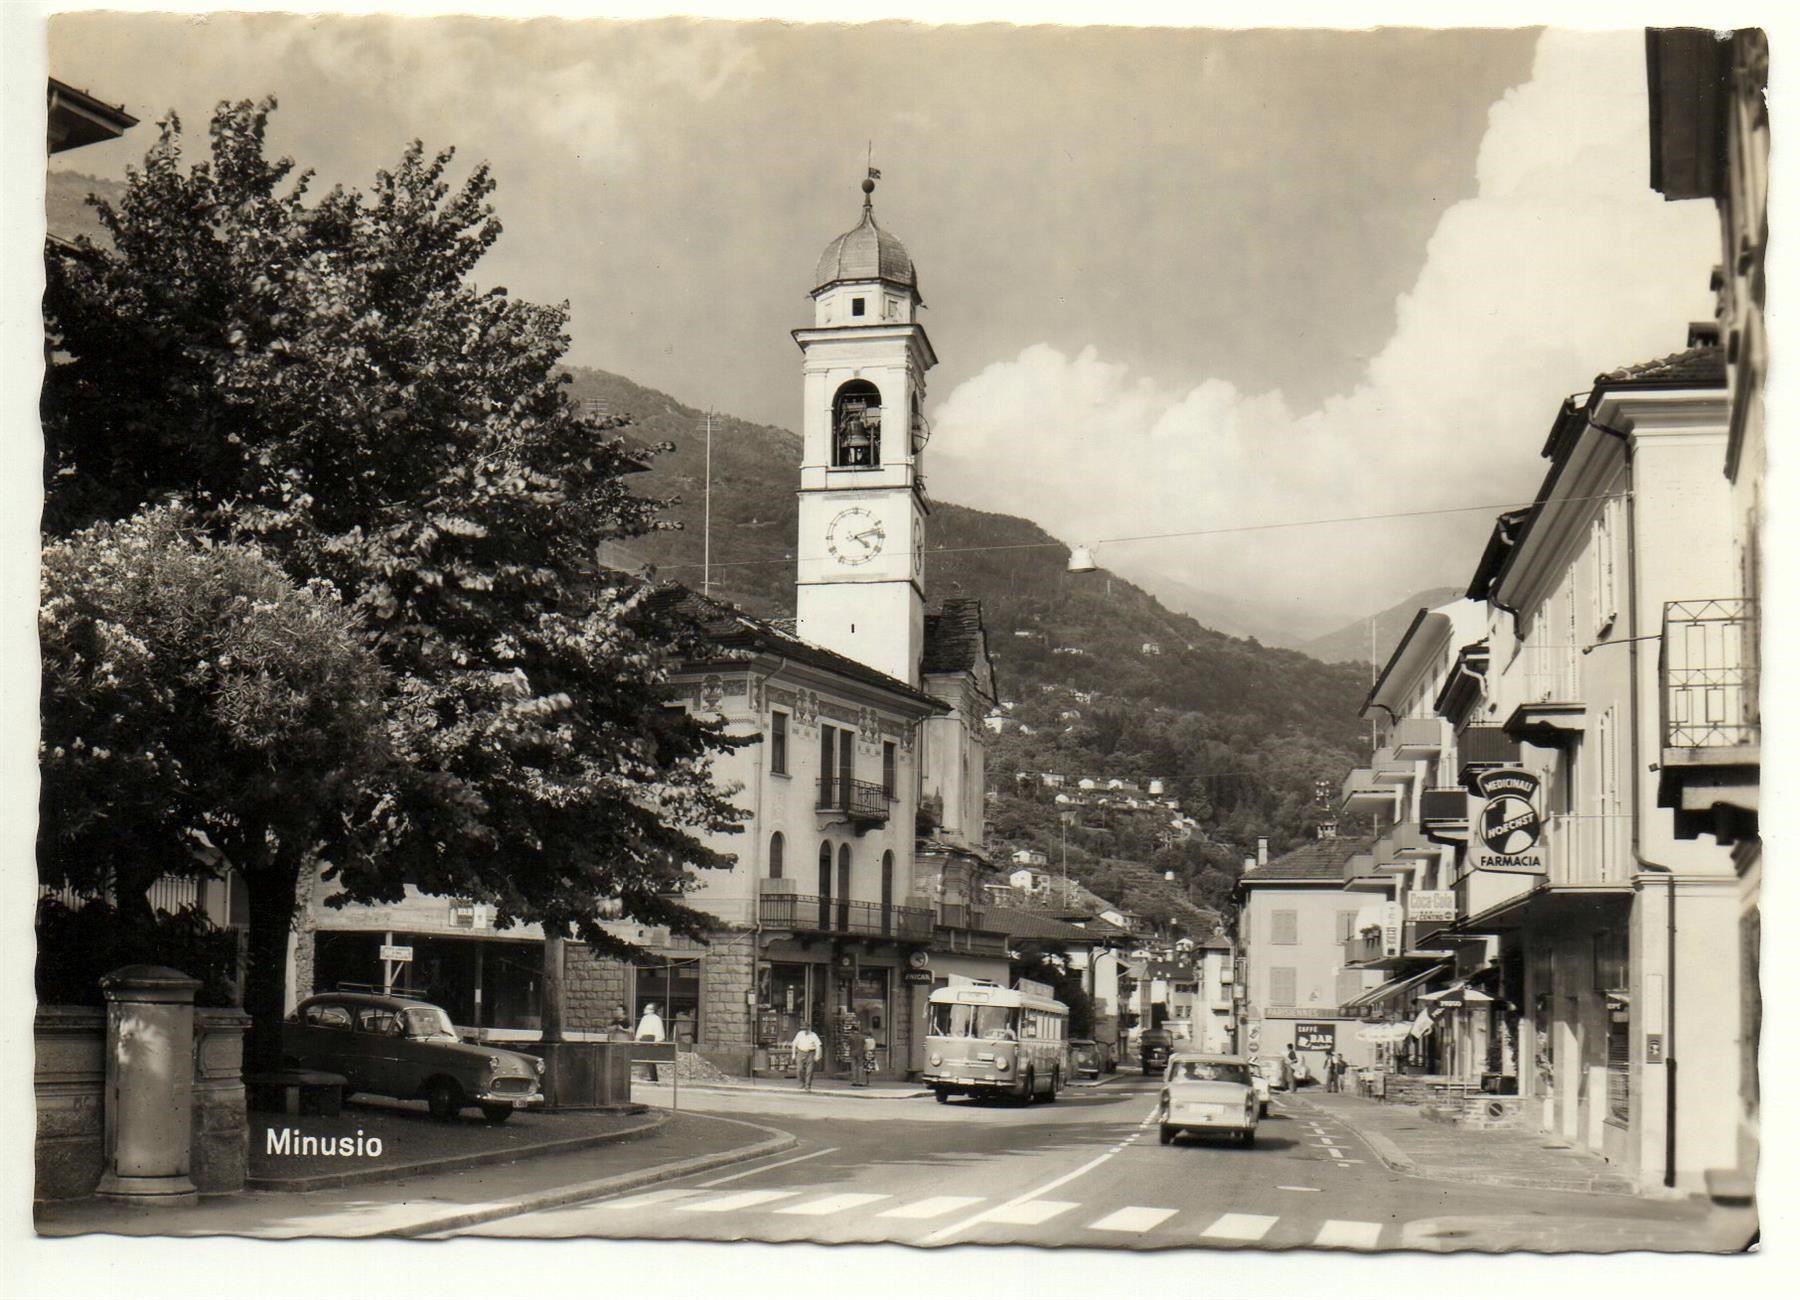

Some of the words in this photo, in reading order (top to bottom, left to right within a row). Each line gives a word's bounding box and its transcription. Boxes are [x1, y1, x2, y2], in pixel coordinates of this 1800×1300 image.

[1484, 778, 1533, 792] MEDICINALI
[1487, 813, 1534, 839] HOECHST
[1480, 856, 1541, 866] FARMACIA
[1309, 1034, 1334, 1044] BAR
